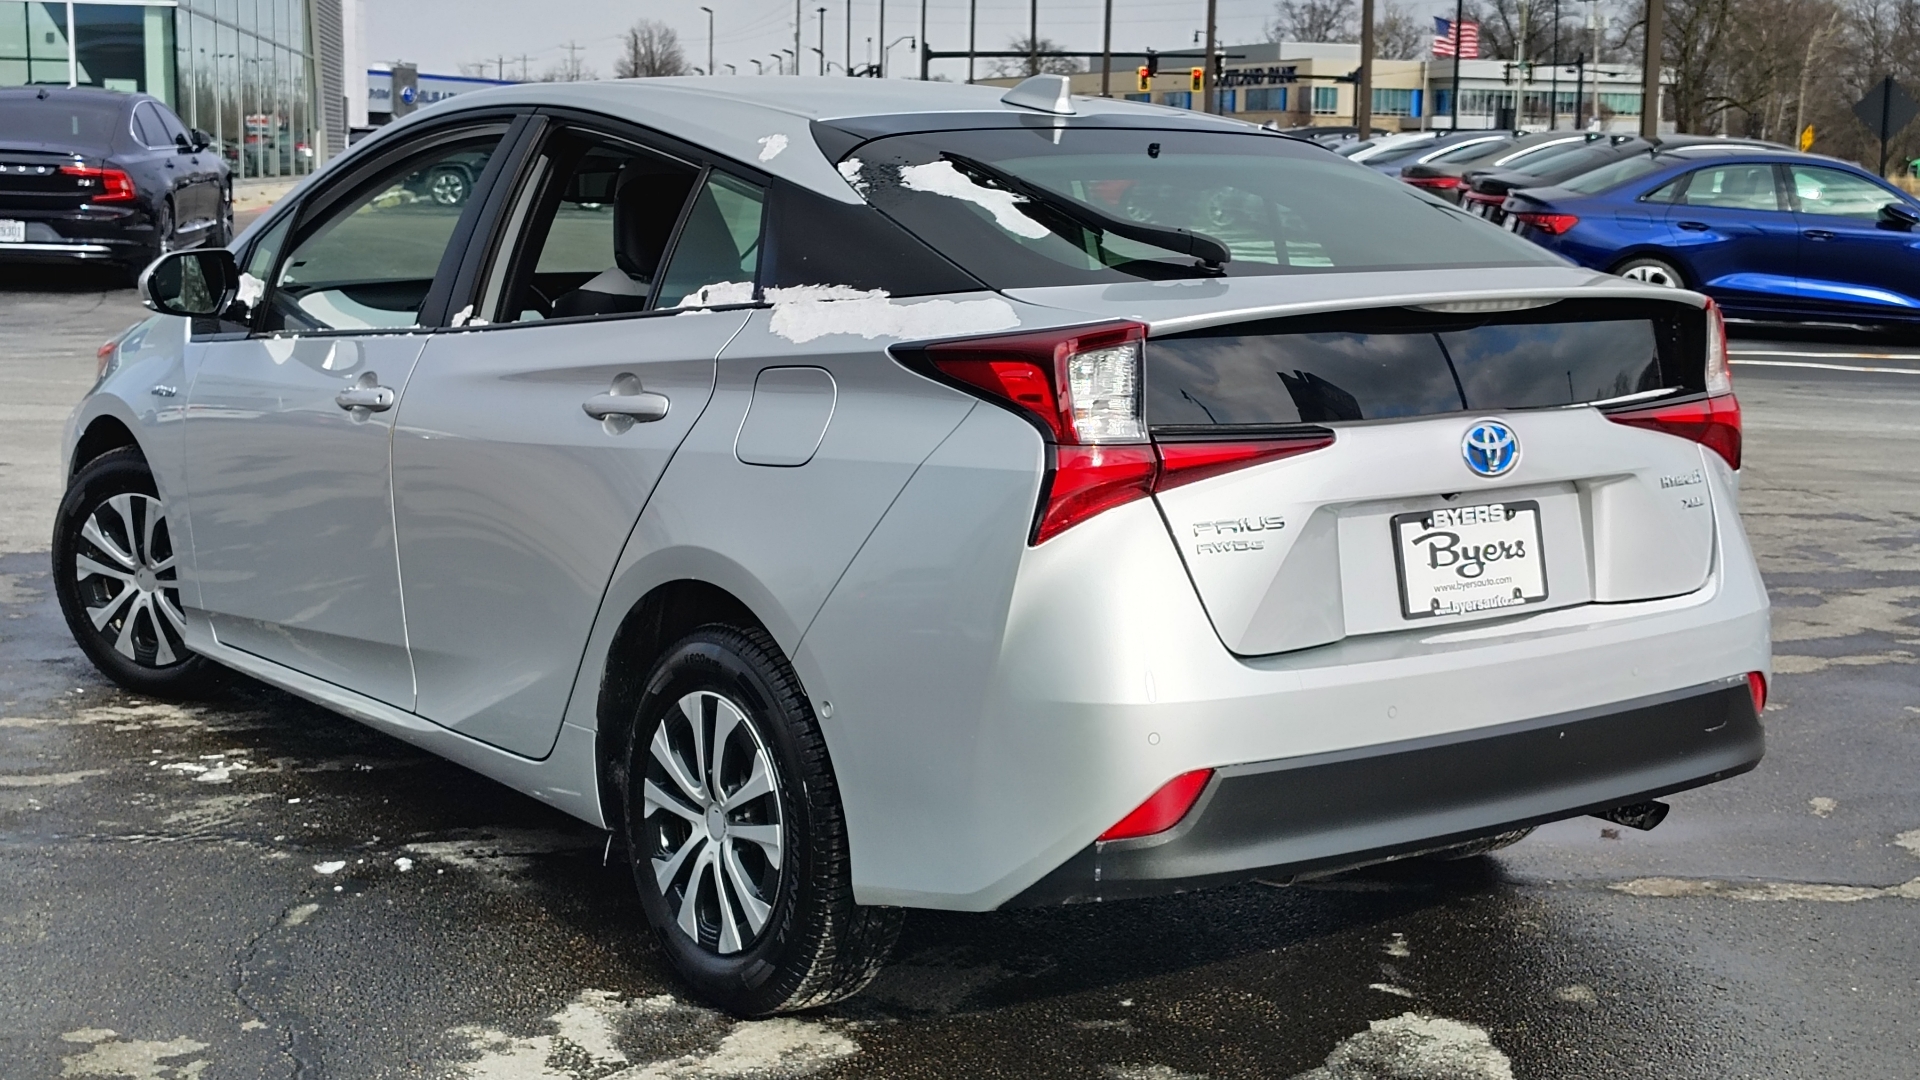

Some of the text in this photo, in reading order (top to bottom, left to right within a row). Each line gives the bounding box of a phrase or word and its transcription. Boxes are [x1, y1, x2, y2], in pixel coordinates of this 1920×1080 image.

[1192, 515, 1285, 538] PRIUS
[1432, 503, 1505, 528] BYERS
[1411, 531, 1526, 579] Byers
[1433, 576, 1513, 592] www.byersauto.com
